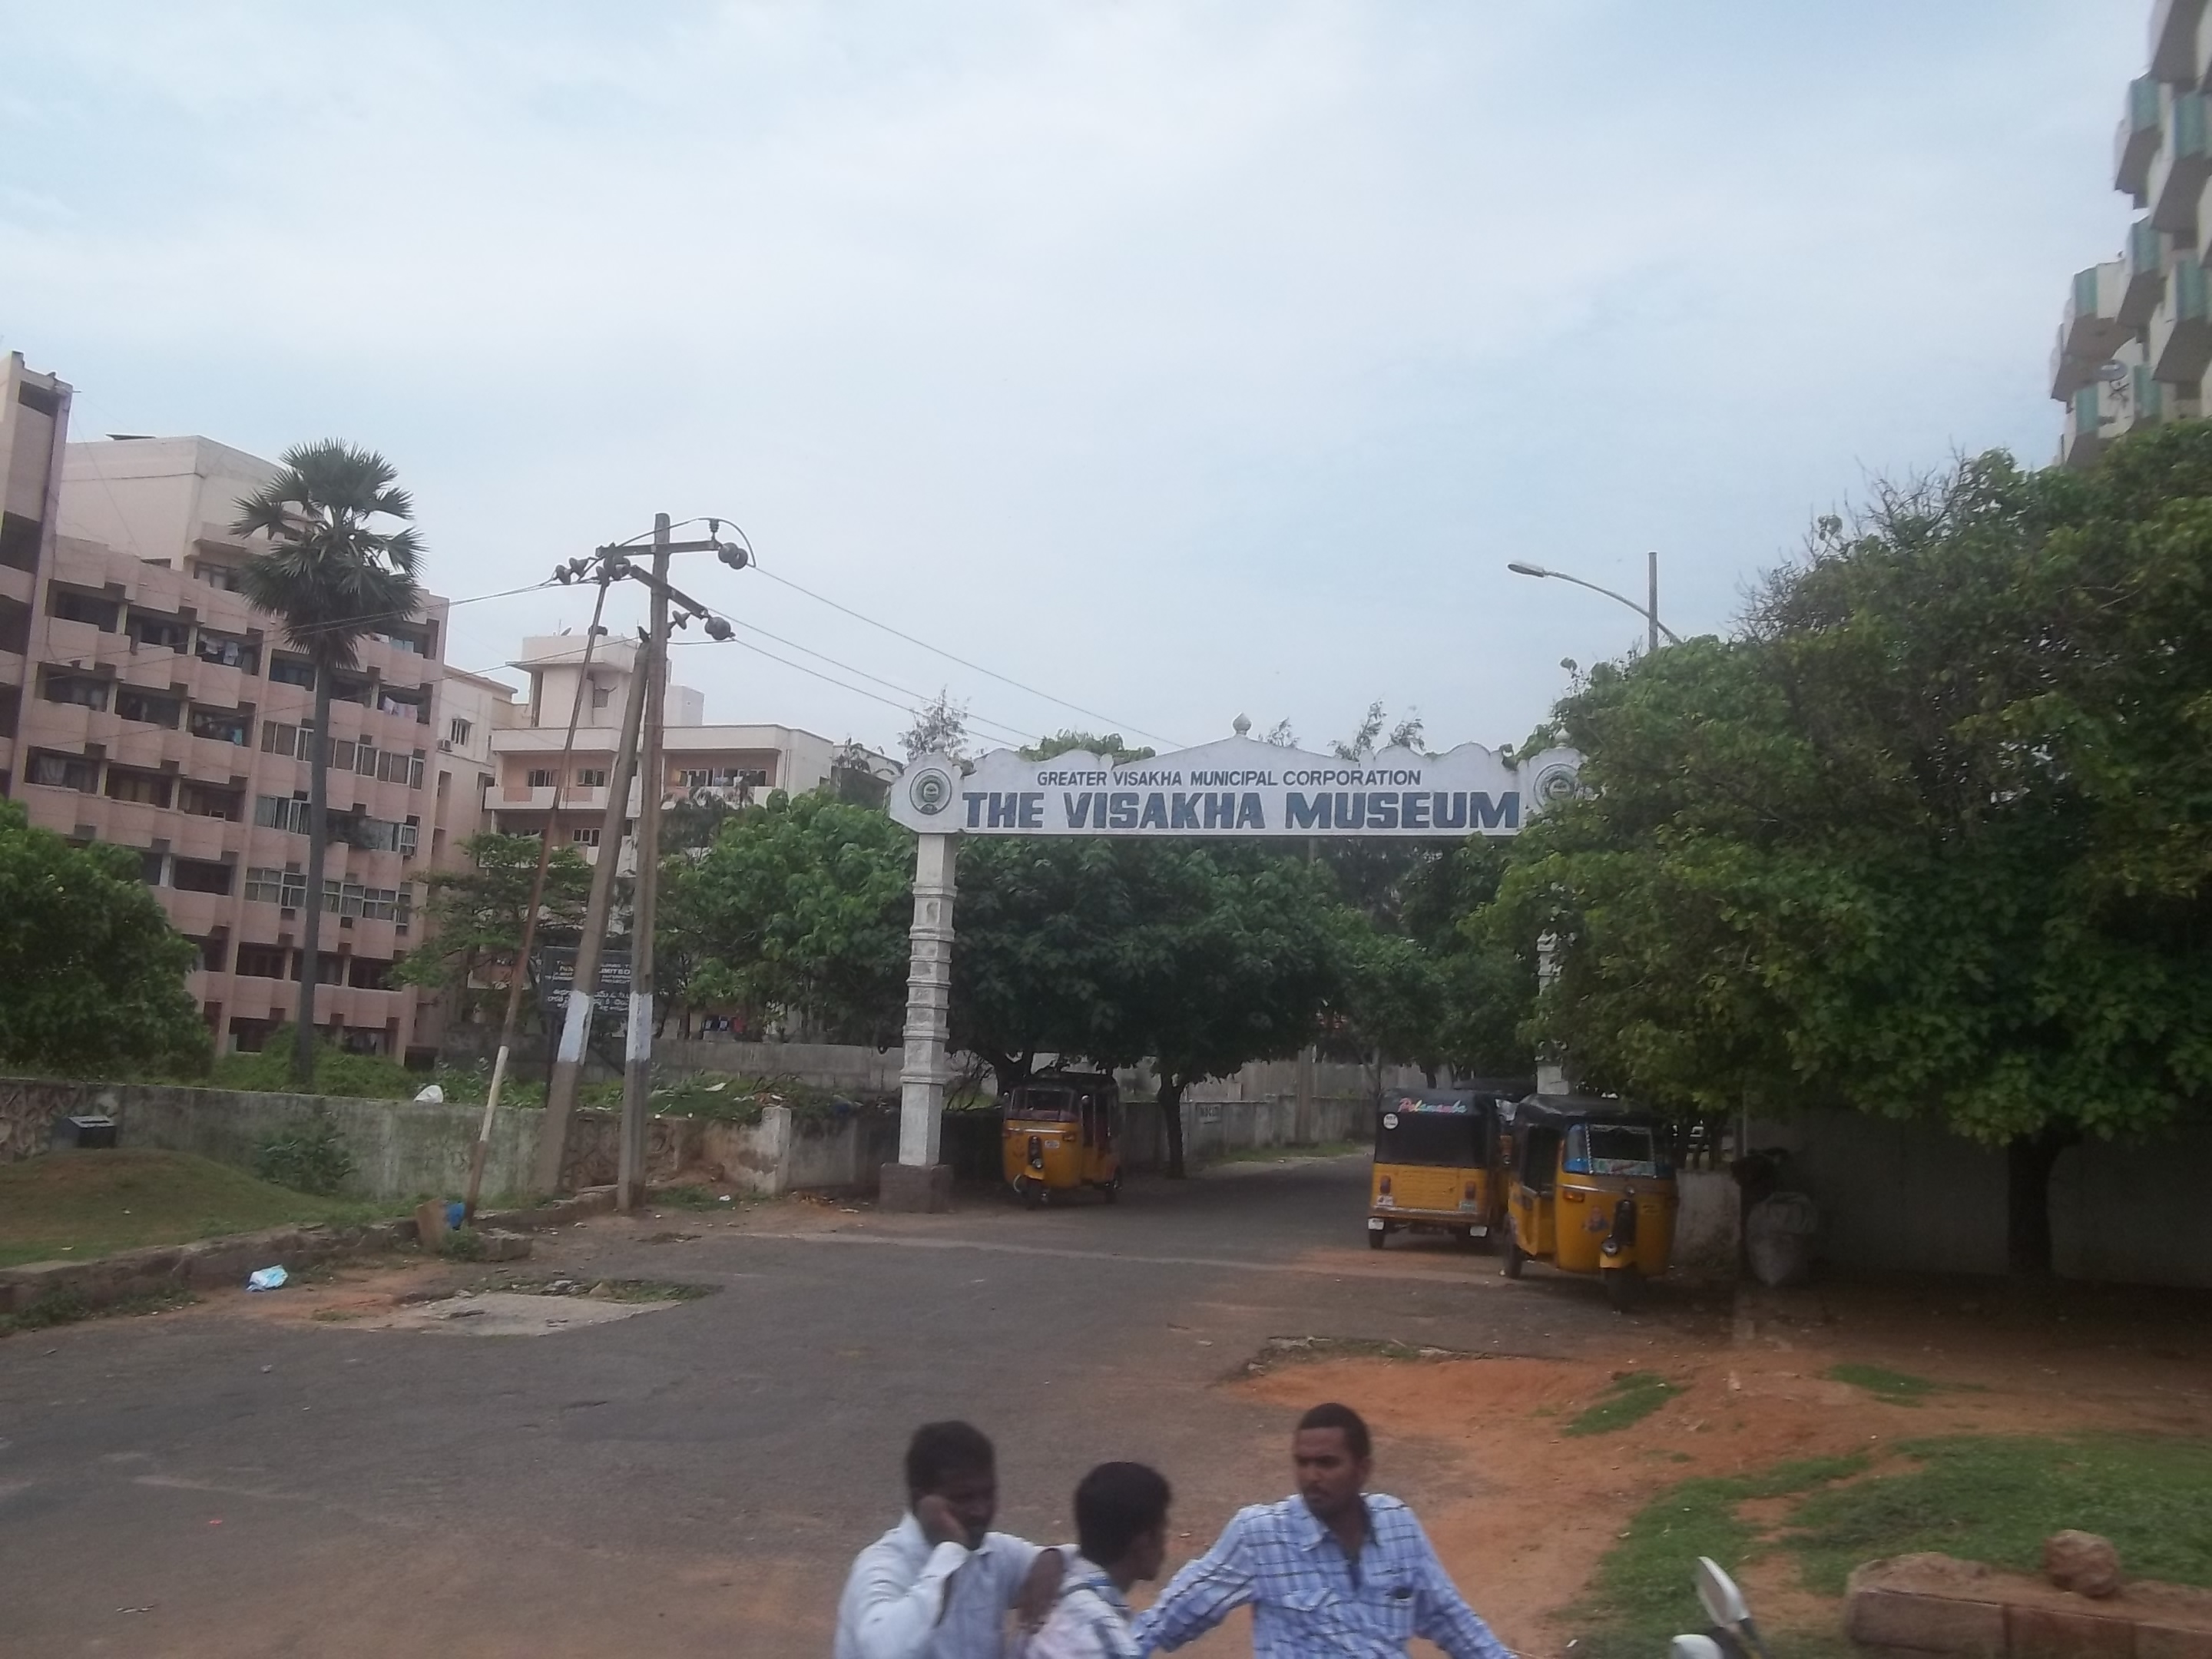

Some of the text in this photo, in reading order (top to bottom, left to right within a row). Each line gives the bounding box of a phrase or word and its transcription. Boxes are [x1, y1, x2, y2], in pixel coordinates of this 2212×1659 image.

[1037, 769, 1422, 786] GREATER VISAKHA MUNICIPAL CORPORATION
[962, 790, 1522, 830] THE VISAKHA MUSEUM
